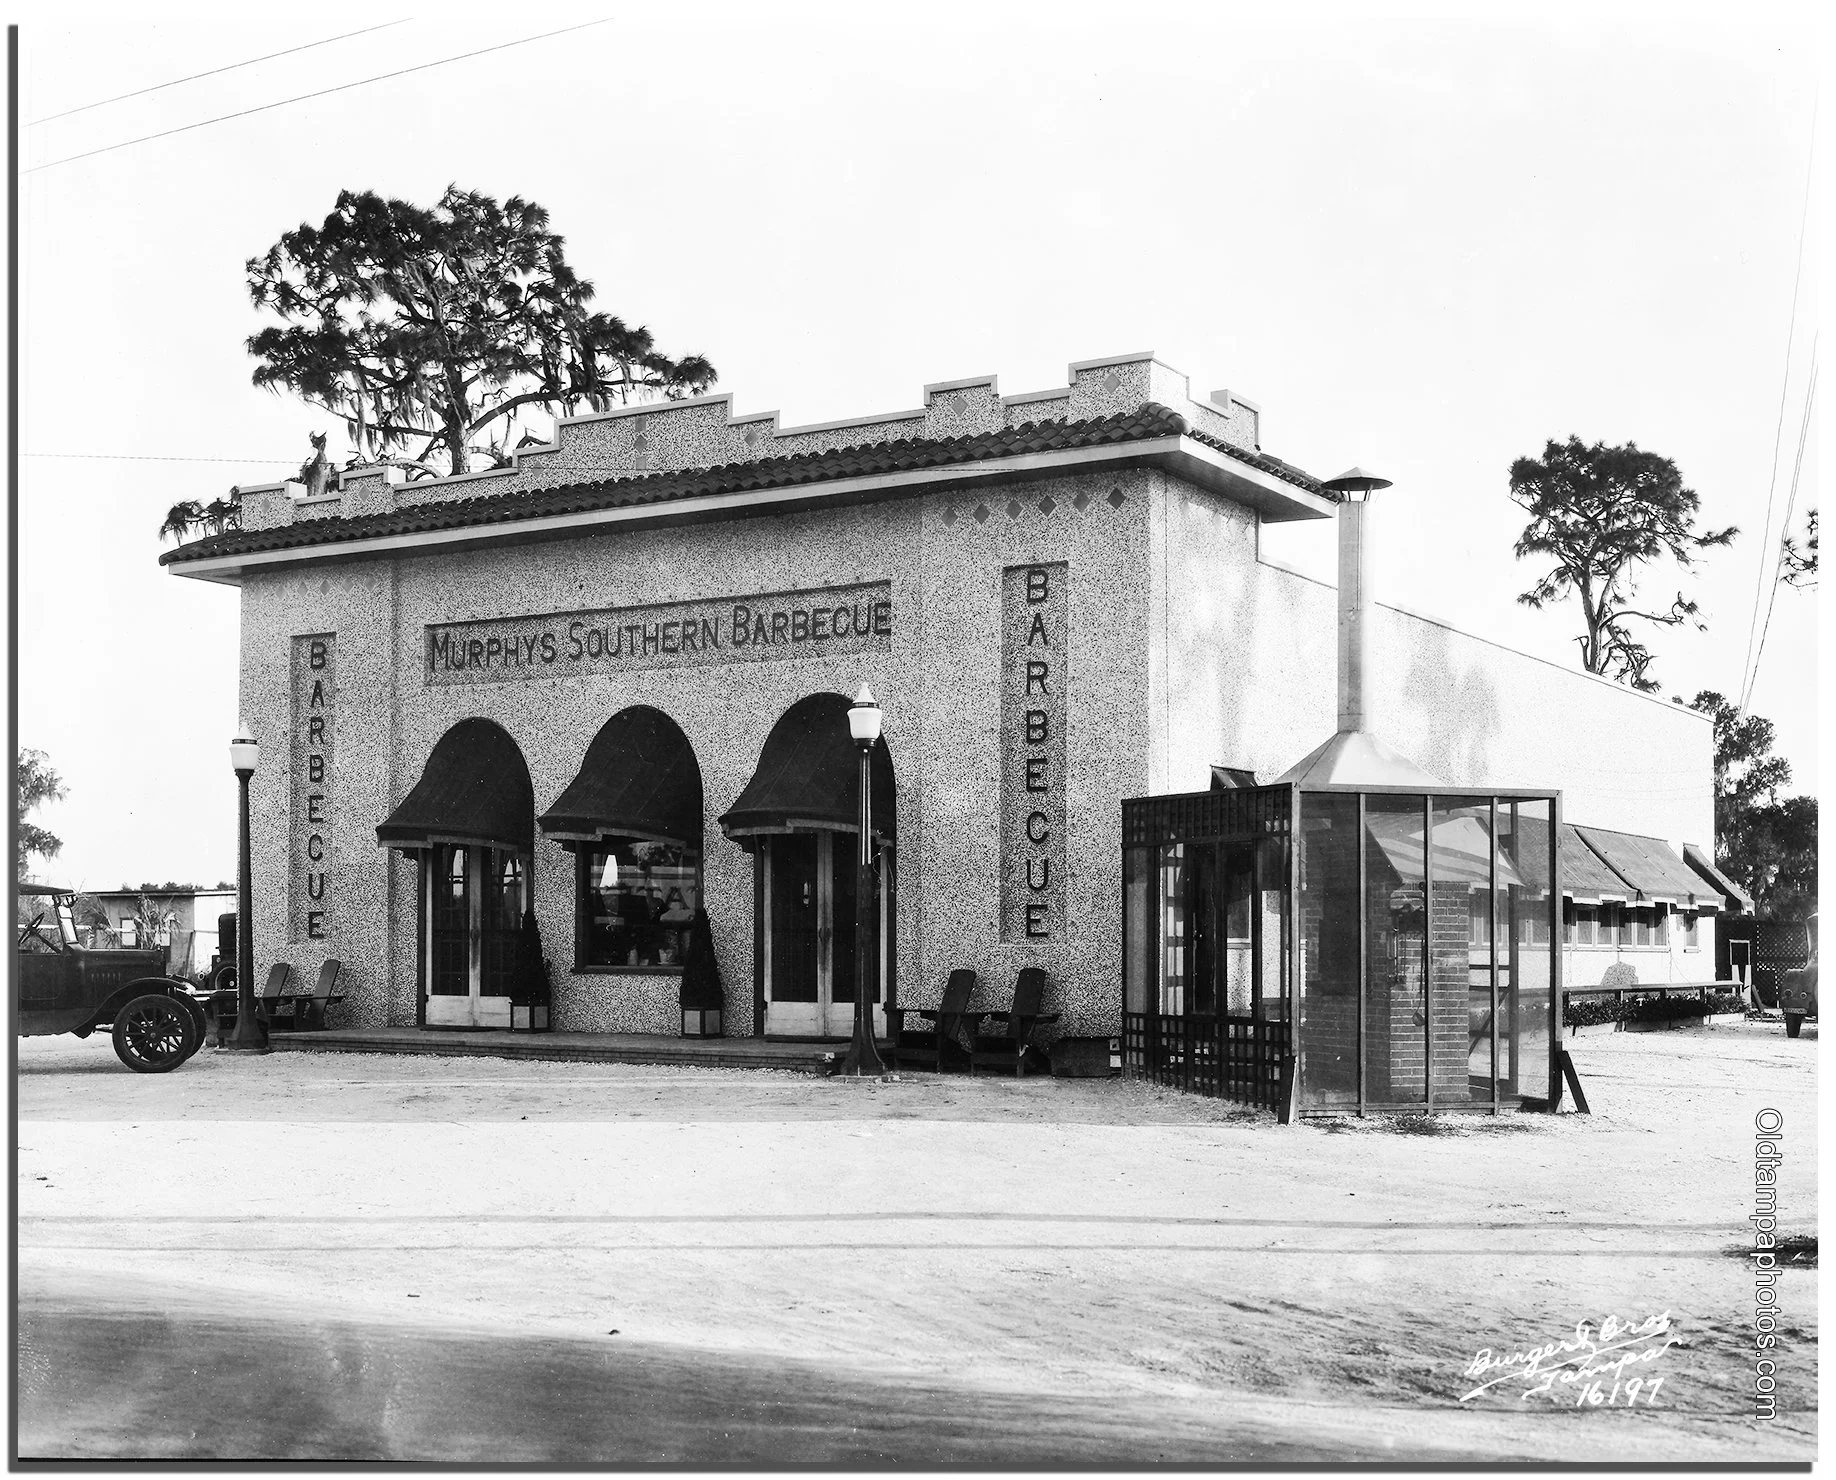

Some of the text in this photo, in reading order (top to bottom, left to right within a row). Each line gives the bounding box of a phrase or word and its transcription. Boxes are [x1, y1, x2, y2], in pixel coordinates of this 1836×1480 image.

[430, 601, 892, 672] MURPHYS SOUTHERN BARBECUE
[1026, 569, 1050, 938] BARBECUE
[307, 641, 328, 938] BARBECUE
